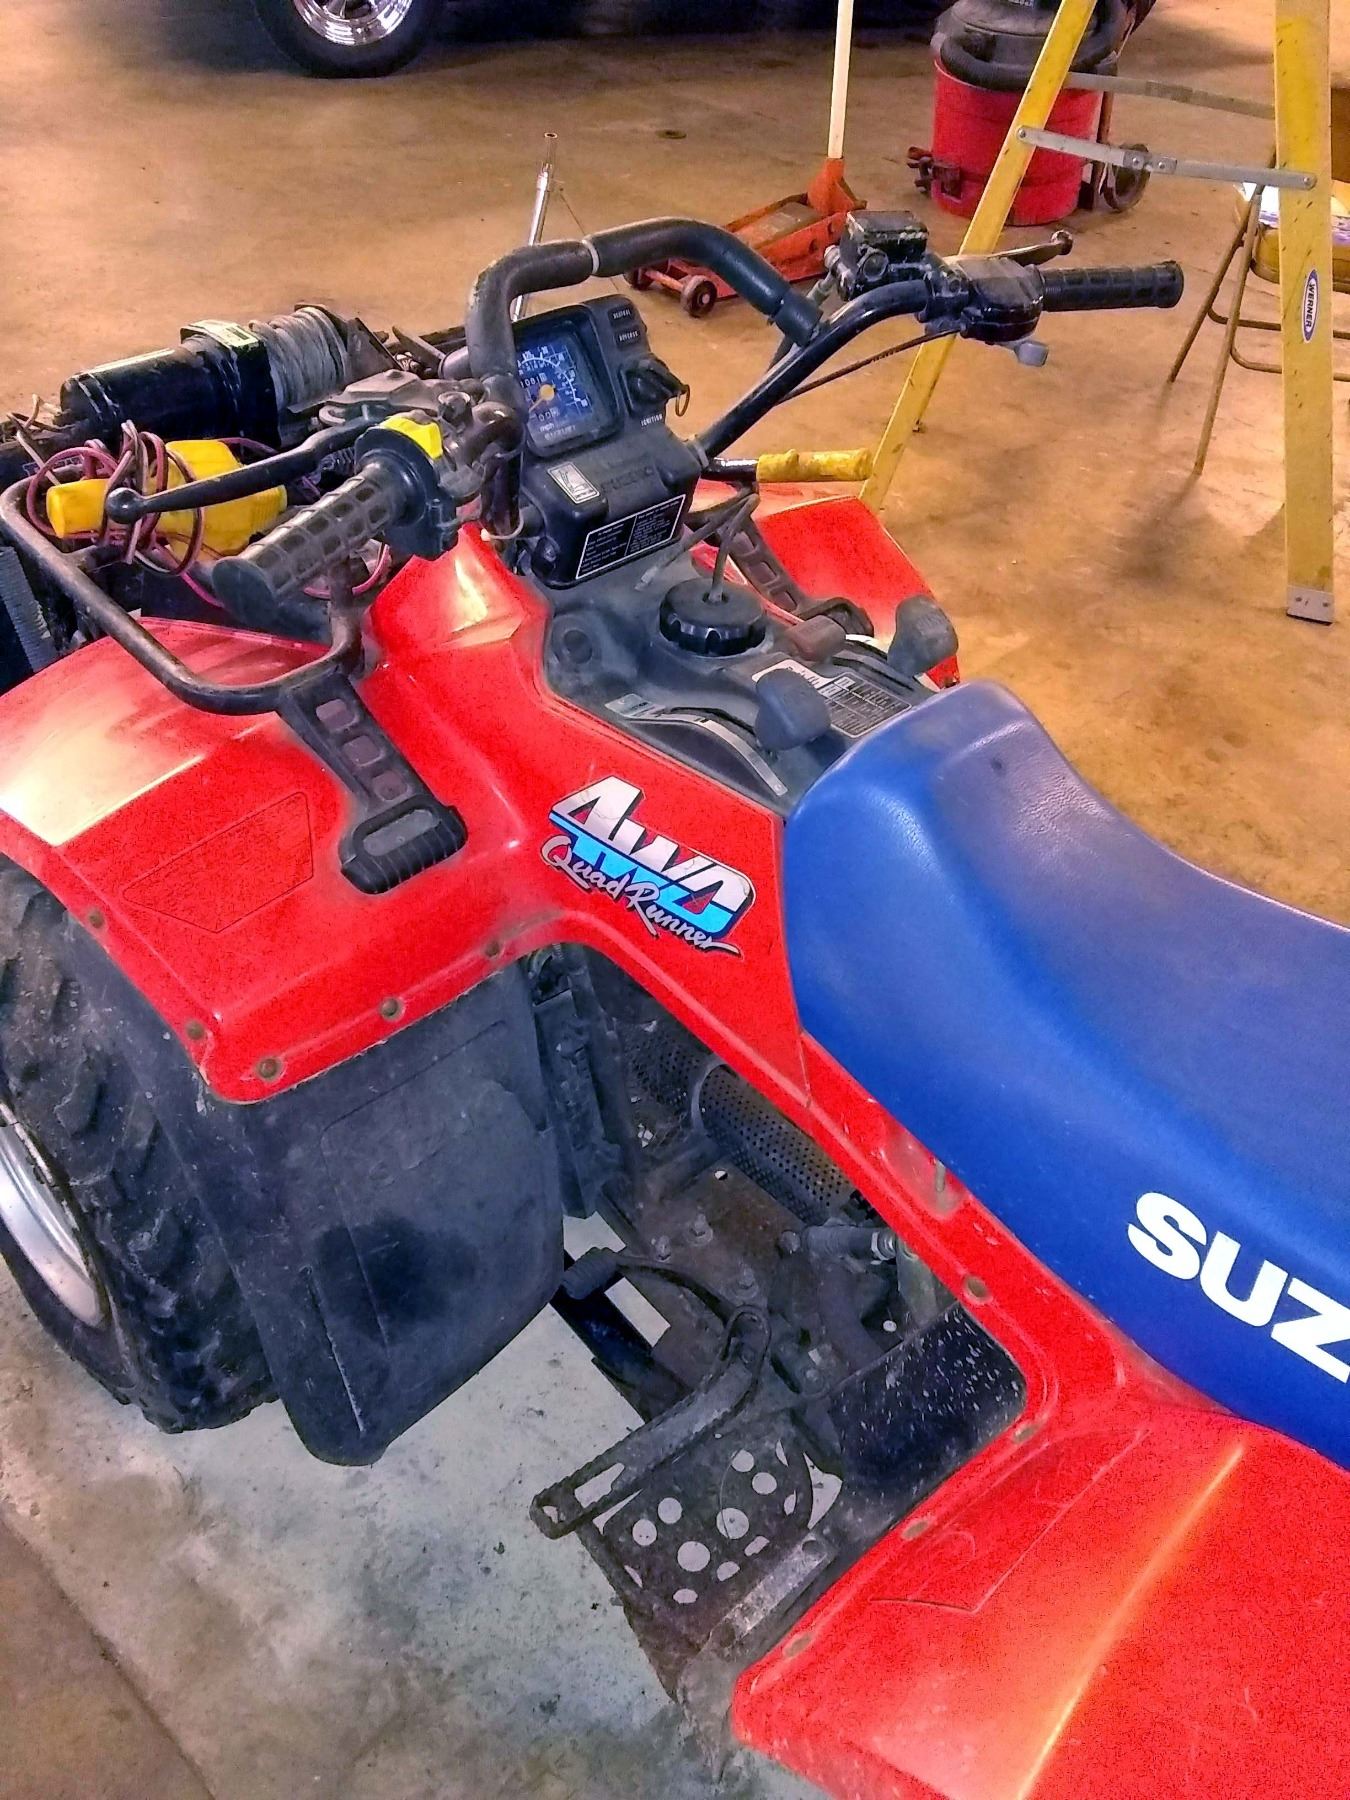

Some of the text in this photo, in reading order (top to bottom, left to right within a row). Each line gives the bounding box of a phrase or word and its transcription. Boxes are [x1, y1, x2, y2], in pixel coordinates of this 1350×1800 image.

[1305, 283, 1315, 328] WERNER
[640, 413, 663, 427] IGNITION
[549, 775, 756, 930] 4WD
[1127, 1192, 1350, 1384] SUZ
